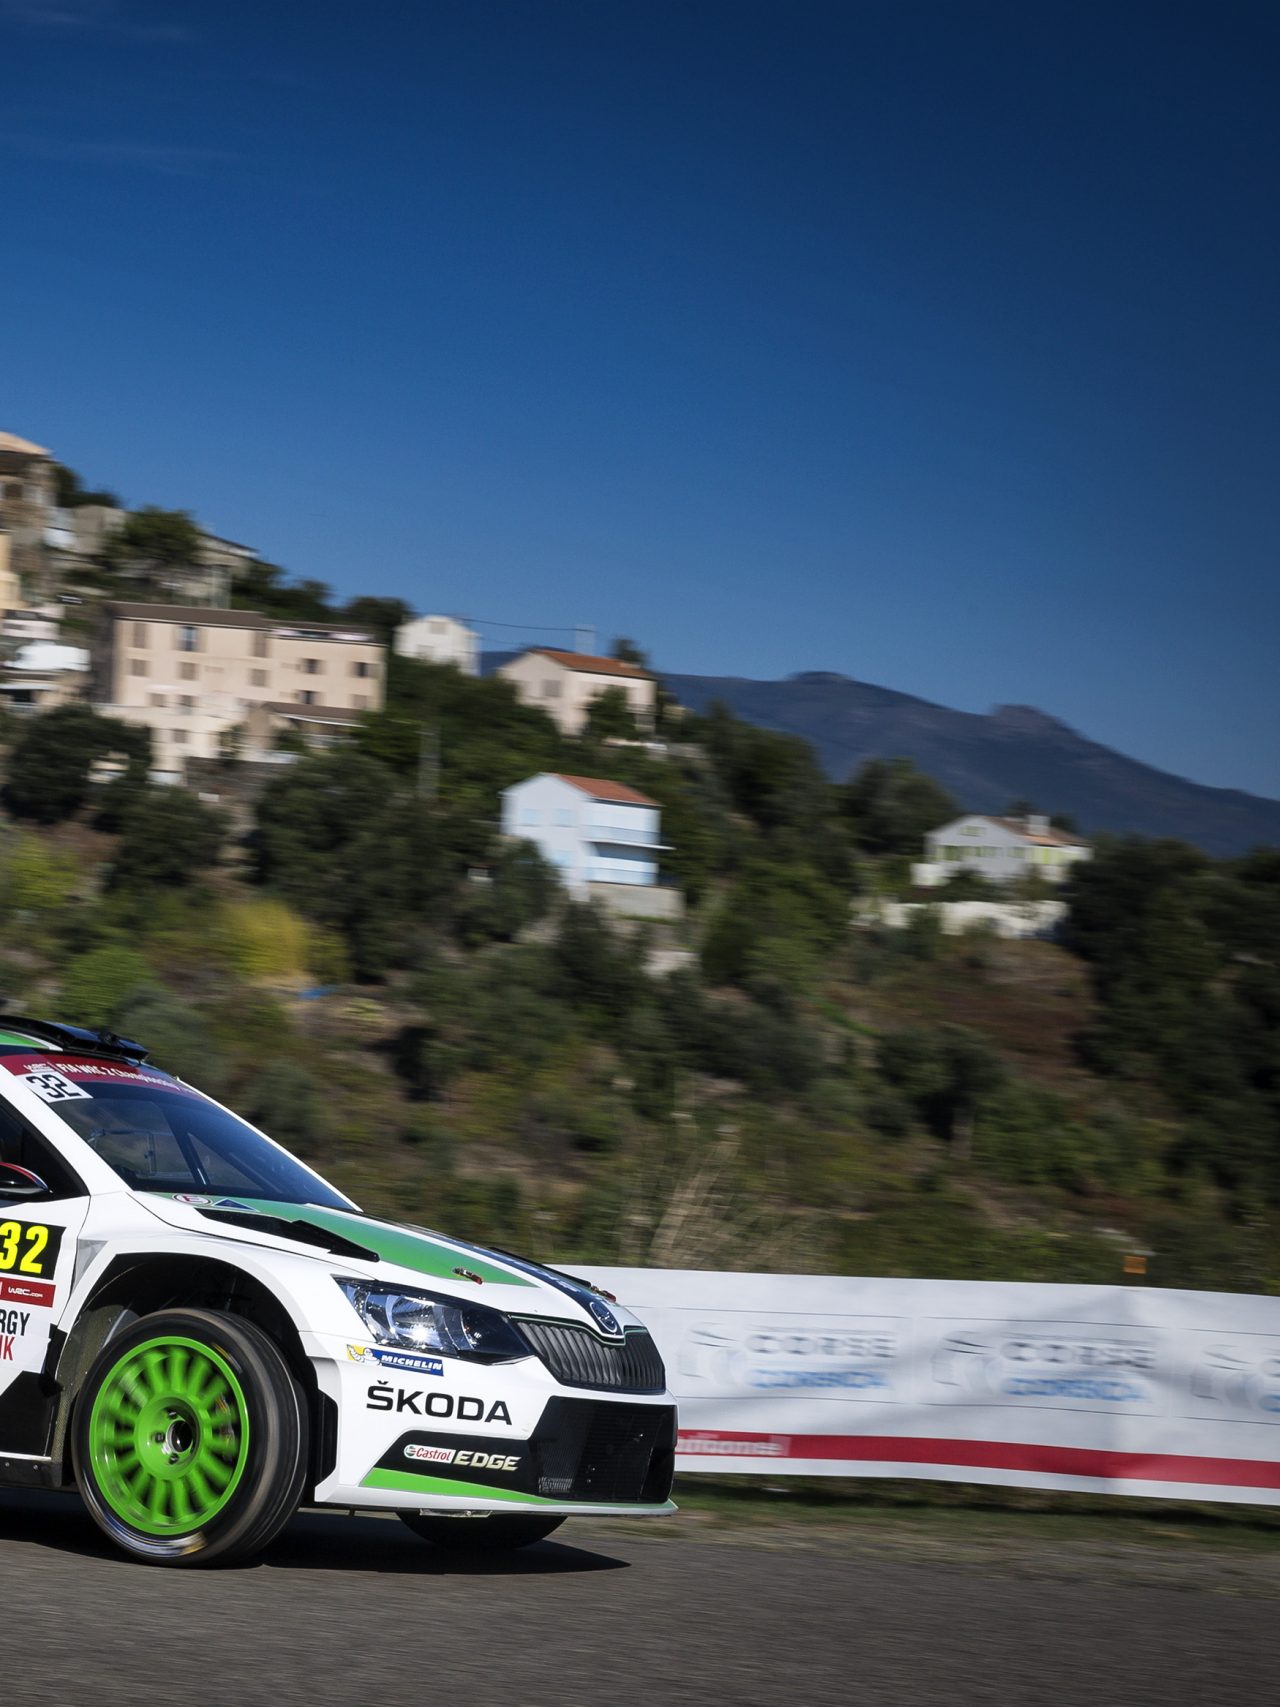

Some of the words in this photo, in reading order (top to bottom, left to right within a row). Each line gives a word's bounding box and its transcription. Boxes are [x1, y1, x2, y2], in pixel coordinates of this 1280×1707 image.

[26, 1074, 82, 1099] 32
[380, 1354, 443, 1371] MICHELIN
[366, 1380, 513, 1426] ŠKODA
[414, 1447, 452, 1462] Castrol
[453, 1450, 522, 1472] EDGE
